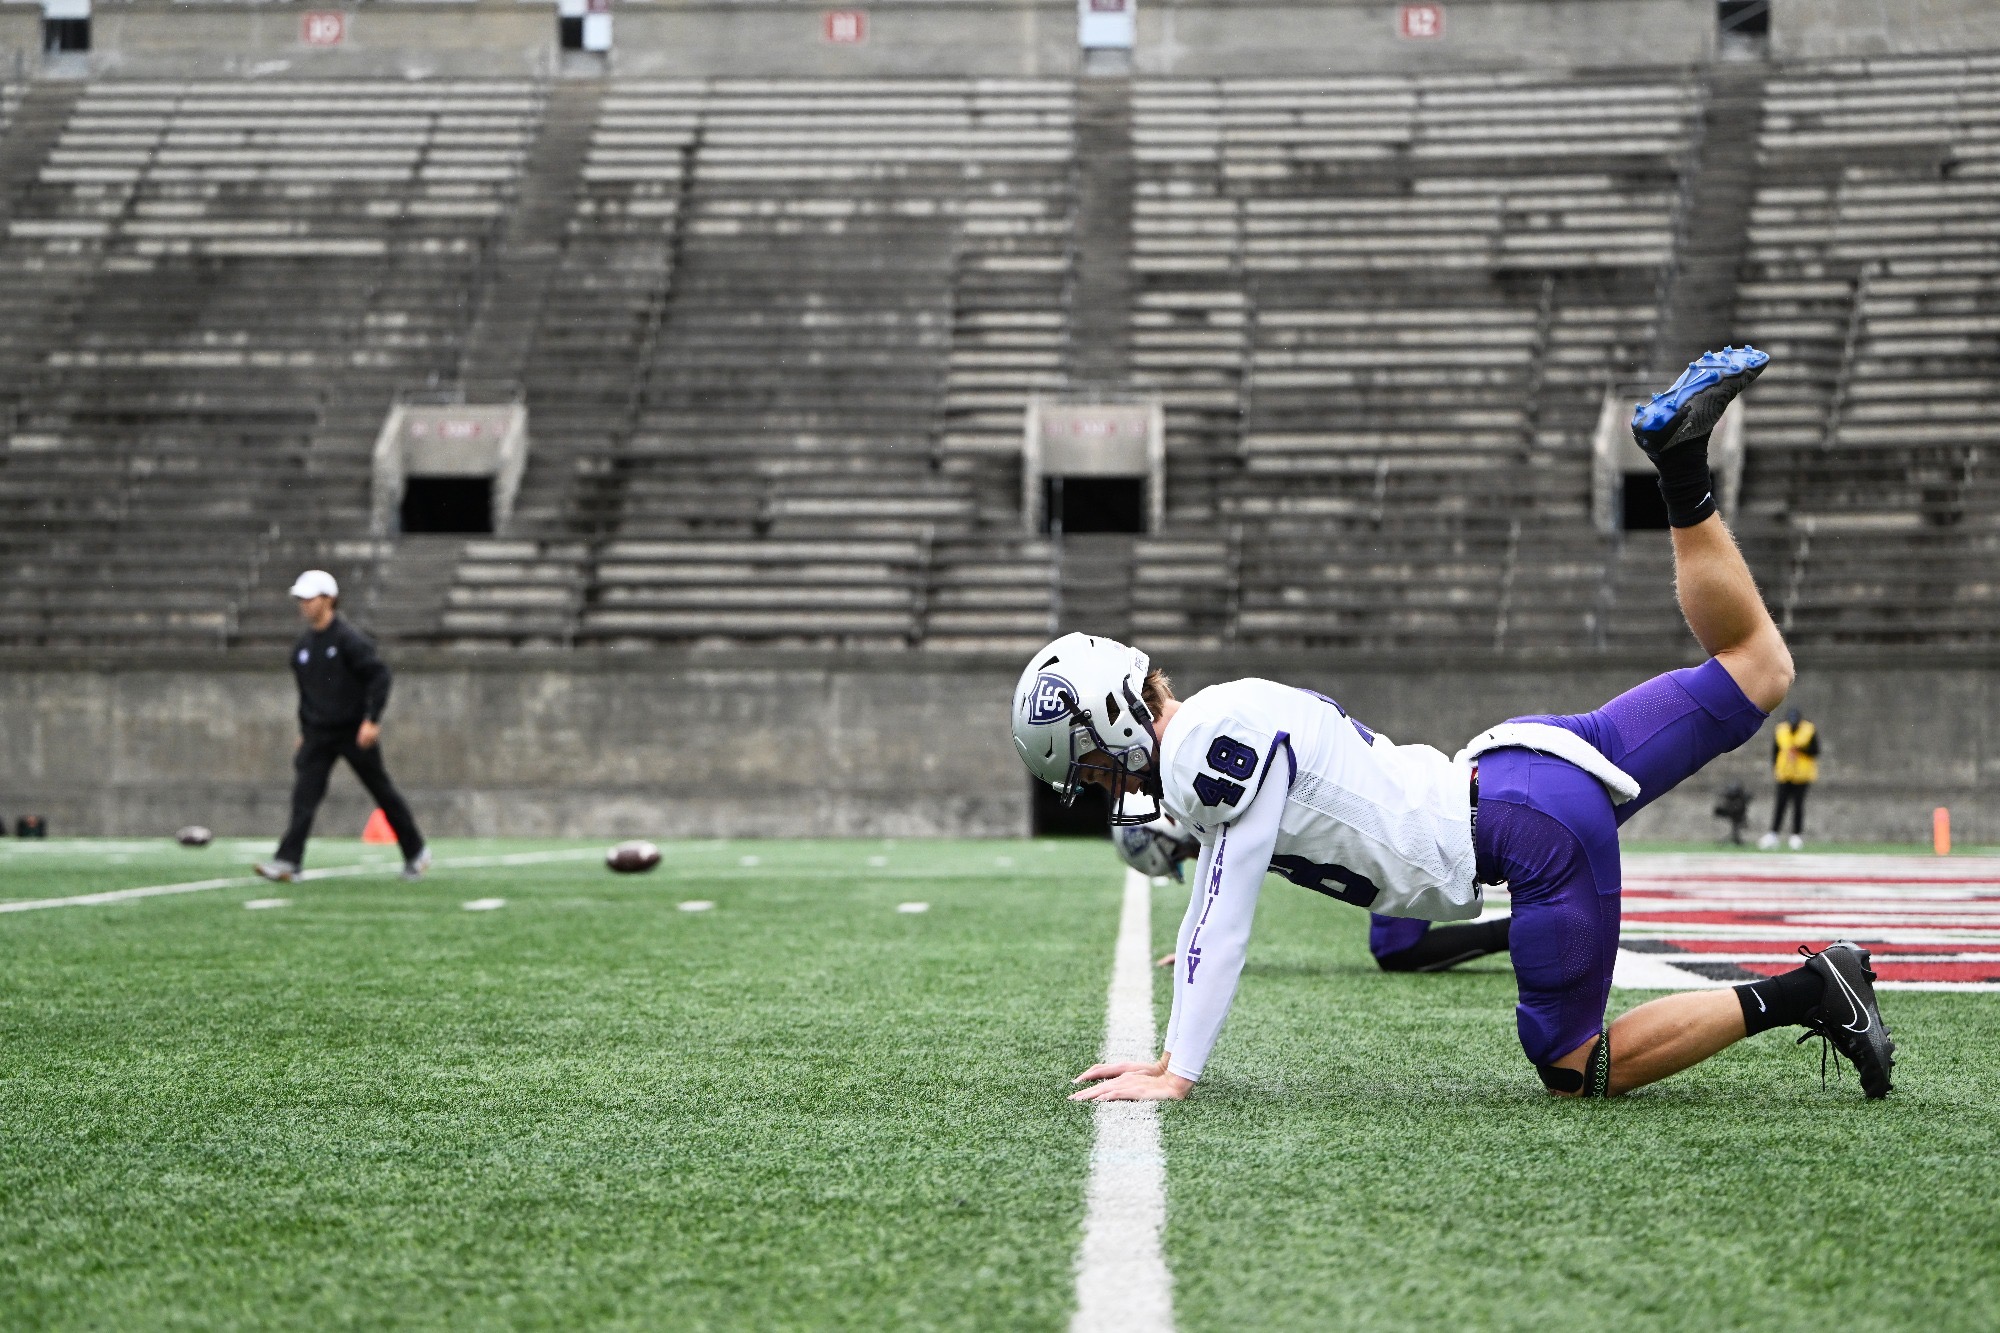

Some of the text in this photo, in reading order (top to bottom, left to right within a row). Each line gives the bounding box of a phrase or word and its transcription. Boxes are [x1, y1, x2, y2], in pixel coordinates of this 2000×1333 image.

[310, 14, 340, 43] 10
[1409, 7, 1434, 36] 12
[1192, 735, 1259, 808] 48
